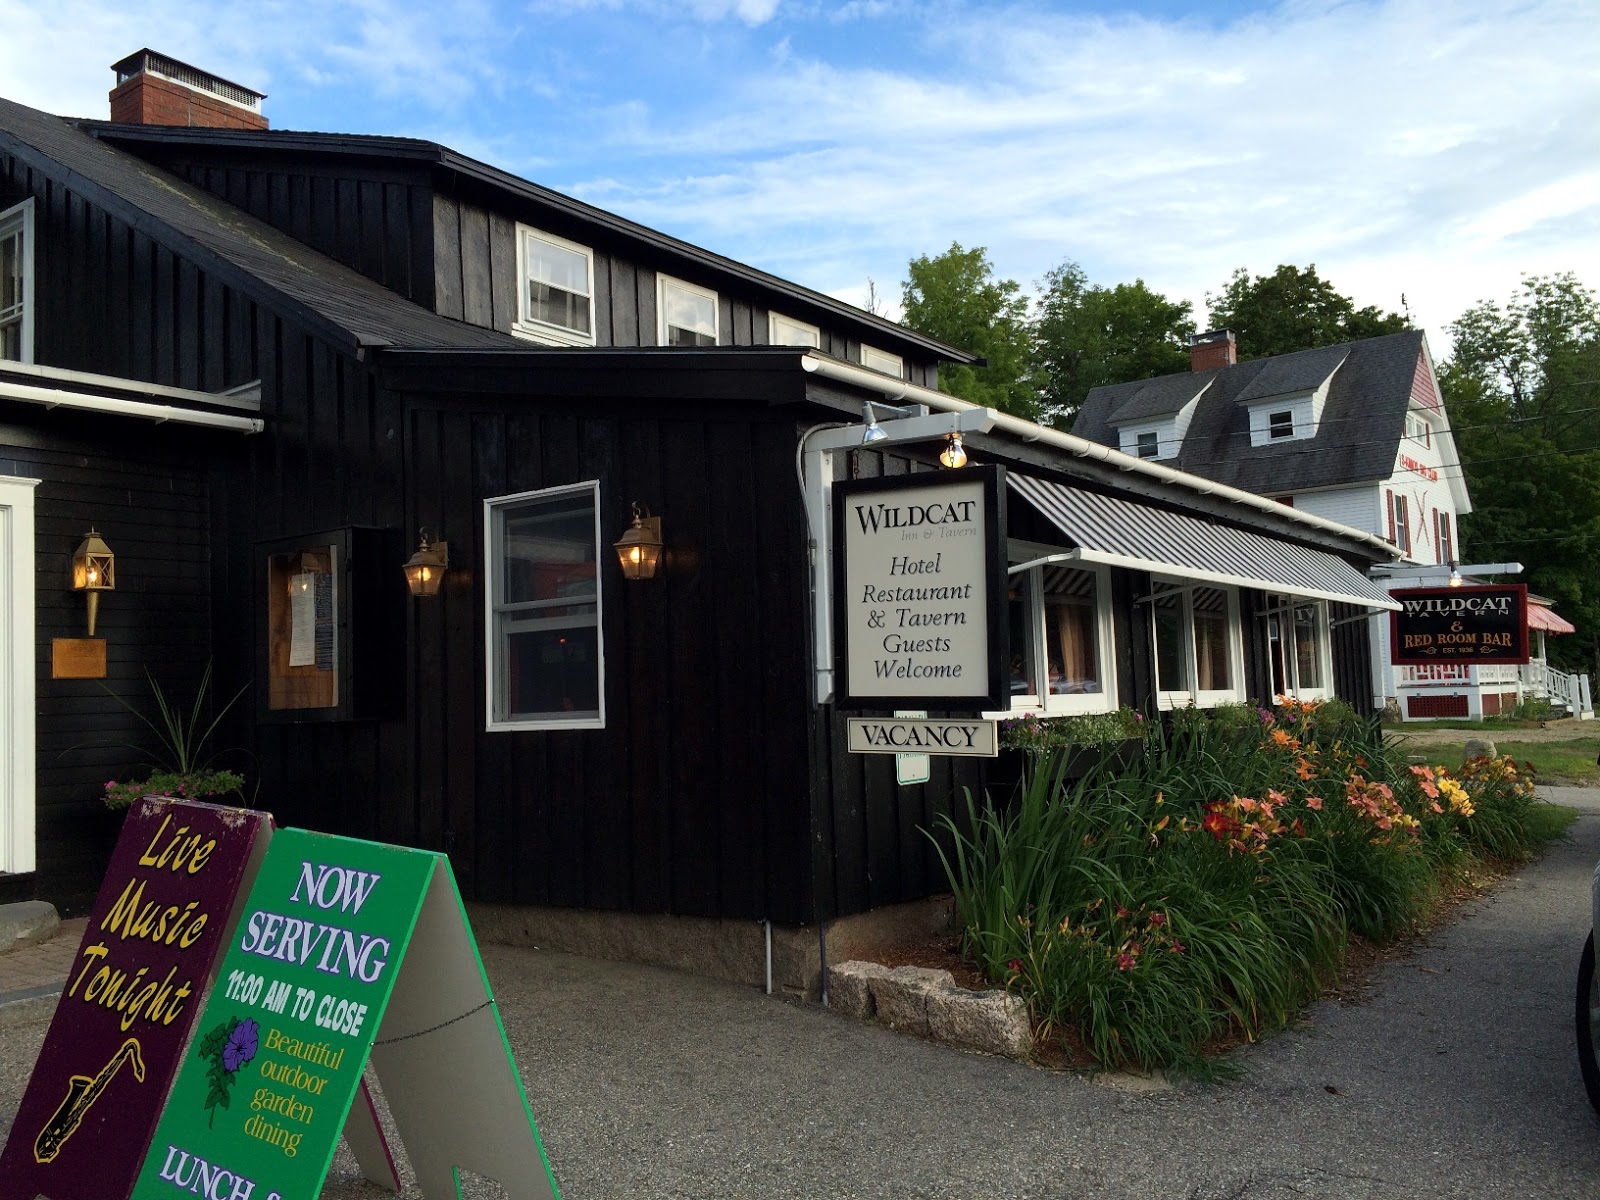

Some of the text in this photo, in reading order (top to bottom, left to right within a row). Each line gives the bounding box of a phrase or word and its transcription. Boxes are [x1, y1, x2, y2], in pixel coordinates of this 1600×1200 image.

[901, 526, 977, 540] Inn & Tavern
[889, 552, 942, 576] Hotel
[862, 583, 972, 604] Restaurant
[1403, 597, 1512, 612] WILDCAT
[867, 608, 967, 629] & Tavern
[1406, 609, 1509, 618] TAVERN
[1450, 620, 1463, 632] &
[882, 633, 951, 654] Guests
[1404, 632, 1512, 648] RED ROOM BAR
[873, 657, 963, 679] Welcome
[861, 724, 979, 748] VACANCY
[138, 813, 217, 874] Live
[288, 860, 381, 916] NOW
[100, 877, 209, 949] Music
[240, 910, 391, 984] SERVING
[68, 941, 192, 1032] Tonight
[225, 968, 369, 1038] 11:00 AM TO CLOSE
[264, 1028, 345, 1071] Beautiful
[260, 1060, 328, 1096] outdoor
[250, 1084, 314, 1125] garden
[244, 1114, 304, 1158] dining
[159, 1145, 256, 1200] LUNCH
